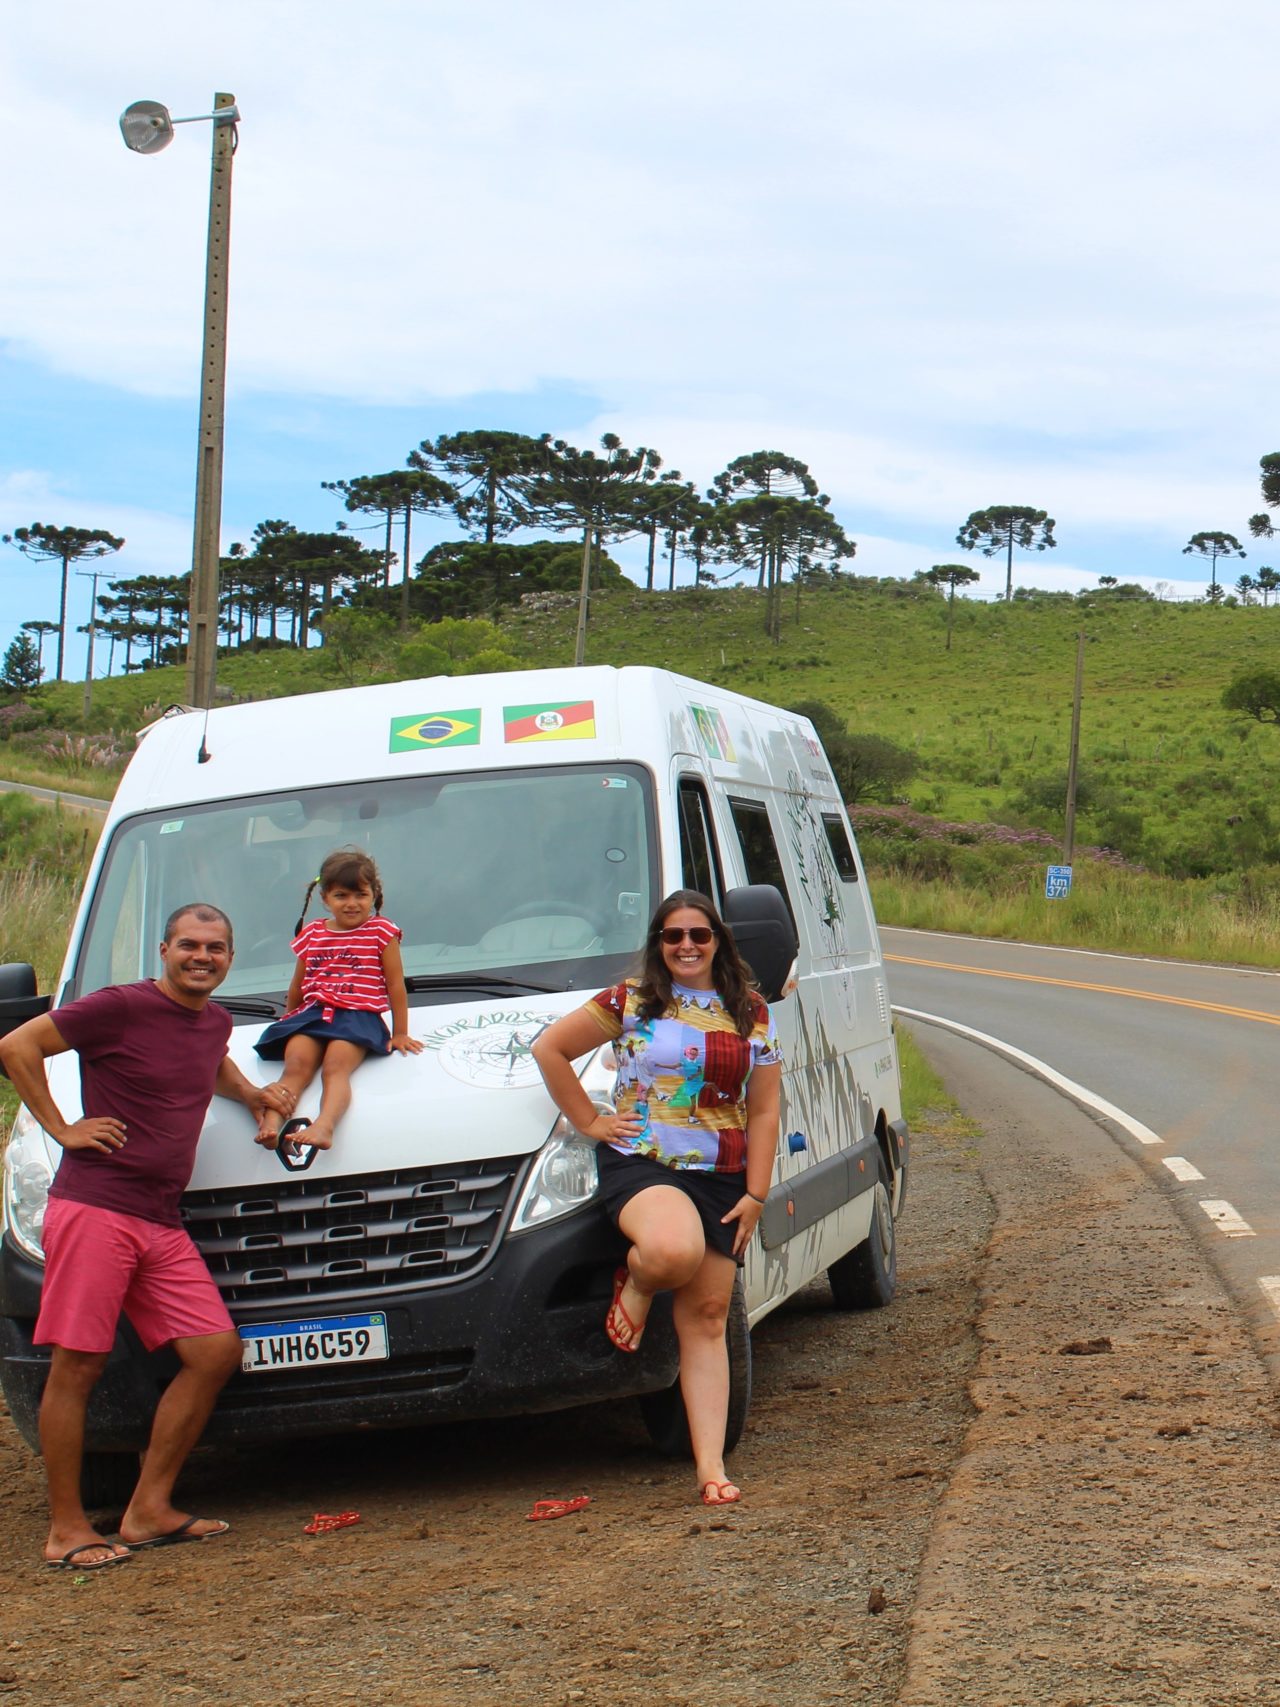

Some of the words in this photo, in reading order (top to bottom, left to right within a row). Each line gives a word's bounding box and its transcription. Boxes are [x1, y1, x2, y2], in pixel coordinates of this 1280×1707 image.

[1050, 876, 1067, 886] km
[1047, 886, 1067, 898] 370
[253, 1329, 370, 1366] IWH6C59
[243, 1361, 252, 1371] BR
